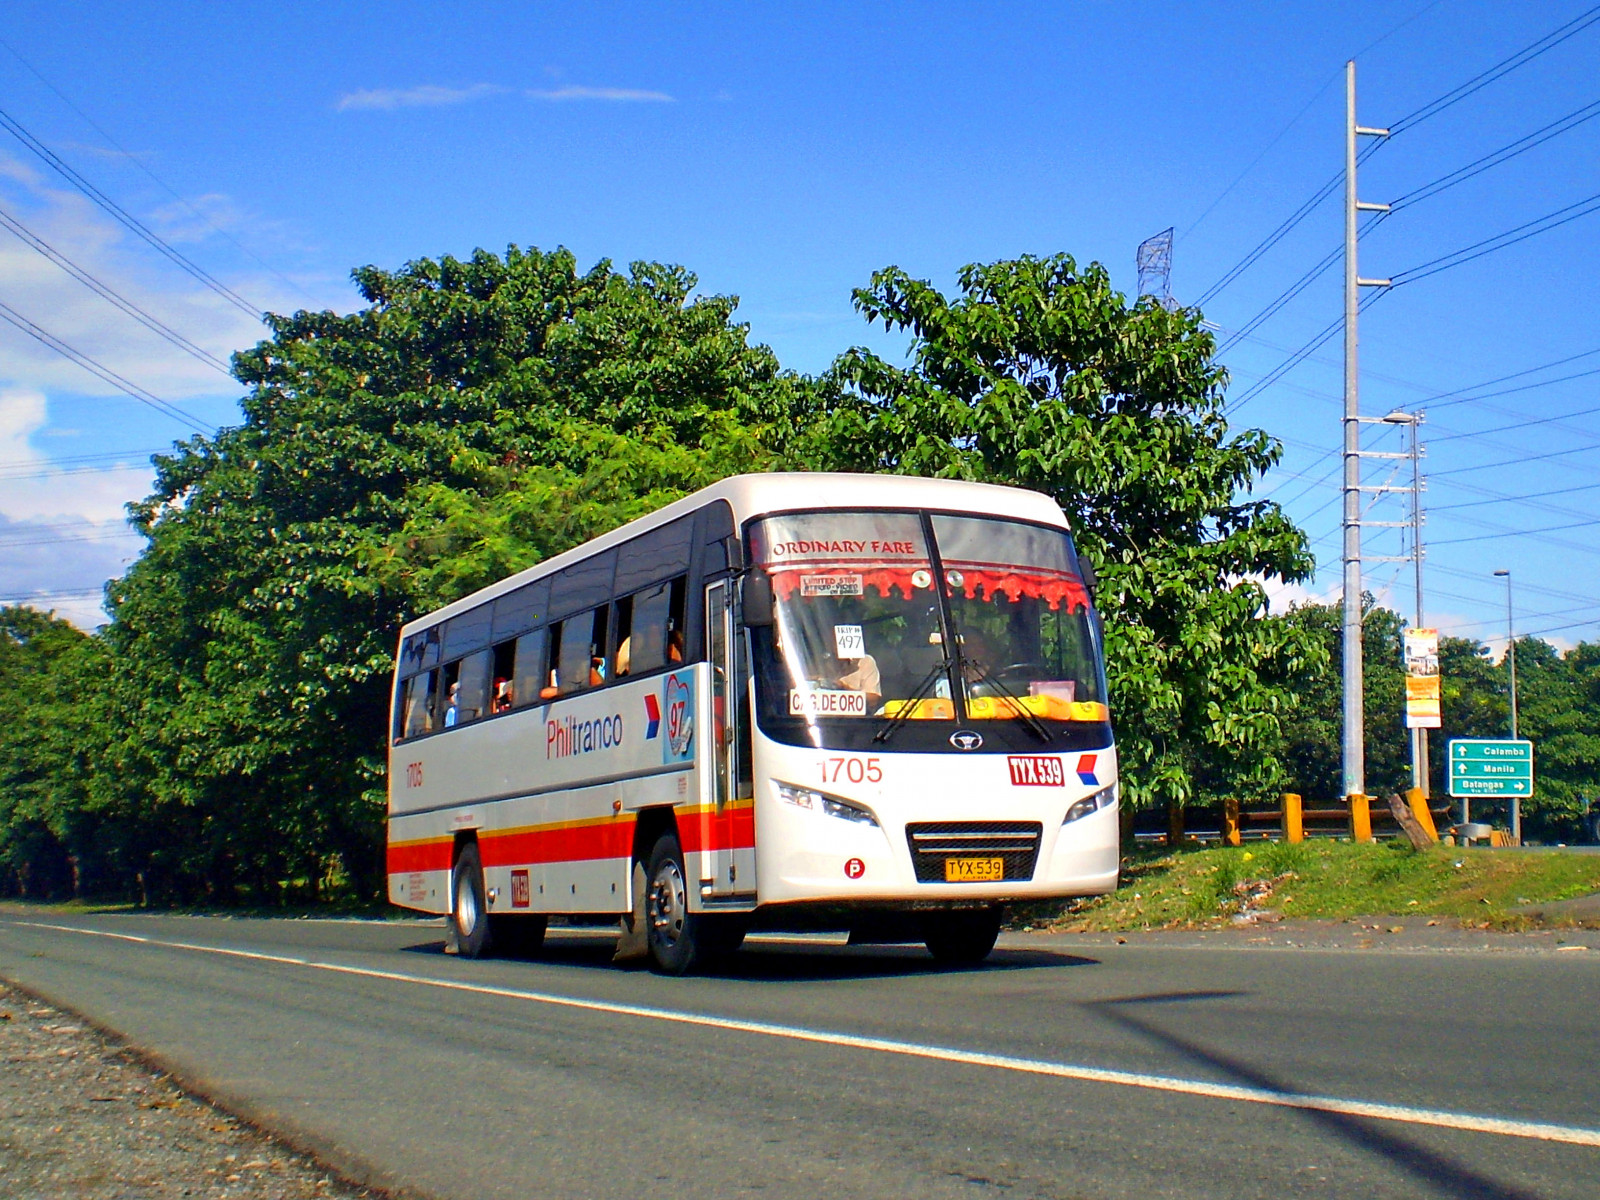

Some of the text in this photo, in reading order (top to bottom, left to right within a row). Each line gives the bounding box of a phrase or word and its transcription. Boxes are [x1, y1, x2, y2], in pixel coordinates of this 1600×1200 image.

[773, 540, 915, 556] ORDINARY FARE
[838, 635, 862, 649] 497
[821, 694, 837, 711] DE
[839, 694, 864, 712] ORO
[670, 701, 685, 738] 97
[546, 713, 623, 760] Philtranco
[1483, 747, 1525, 756] Calamba
[406, 761, 423, 788] 1705
[816, 757, 883, 783] 1705
[1011, 758, 1063, 785] TYX 539
[1483, 765, 1515, 773] Manila
[1462, 781, 1504, 790] Batangas
